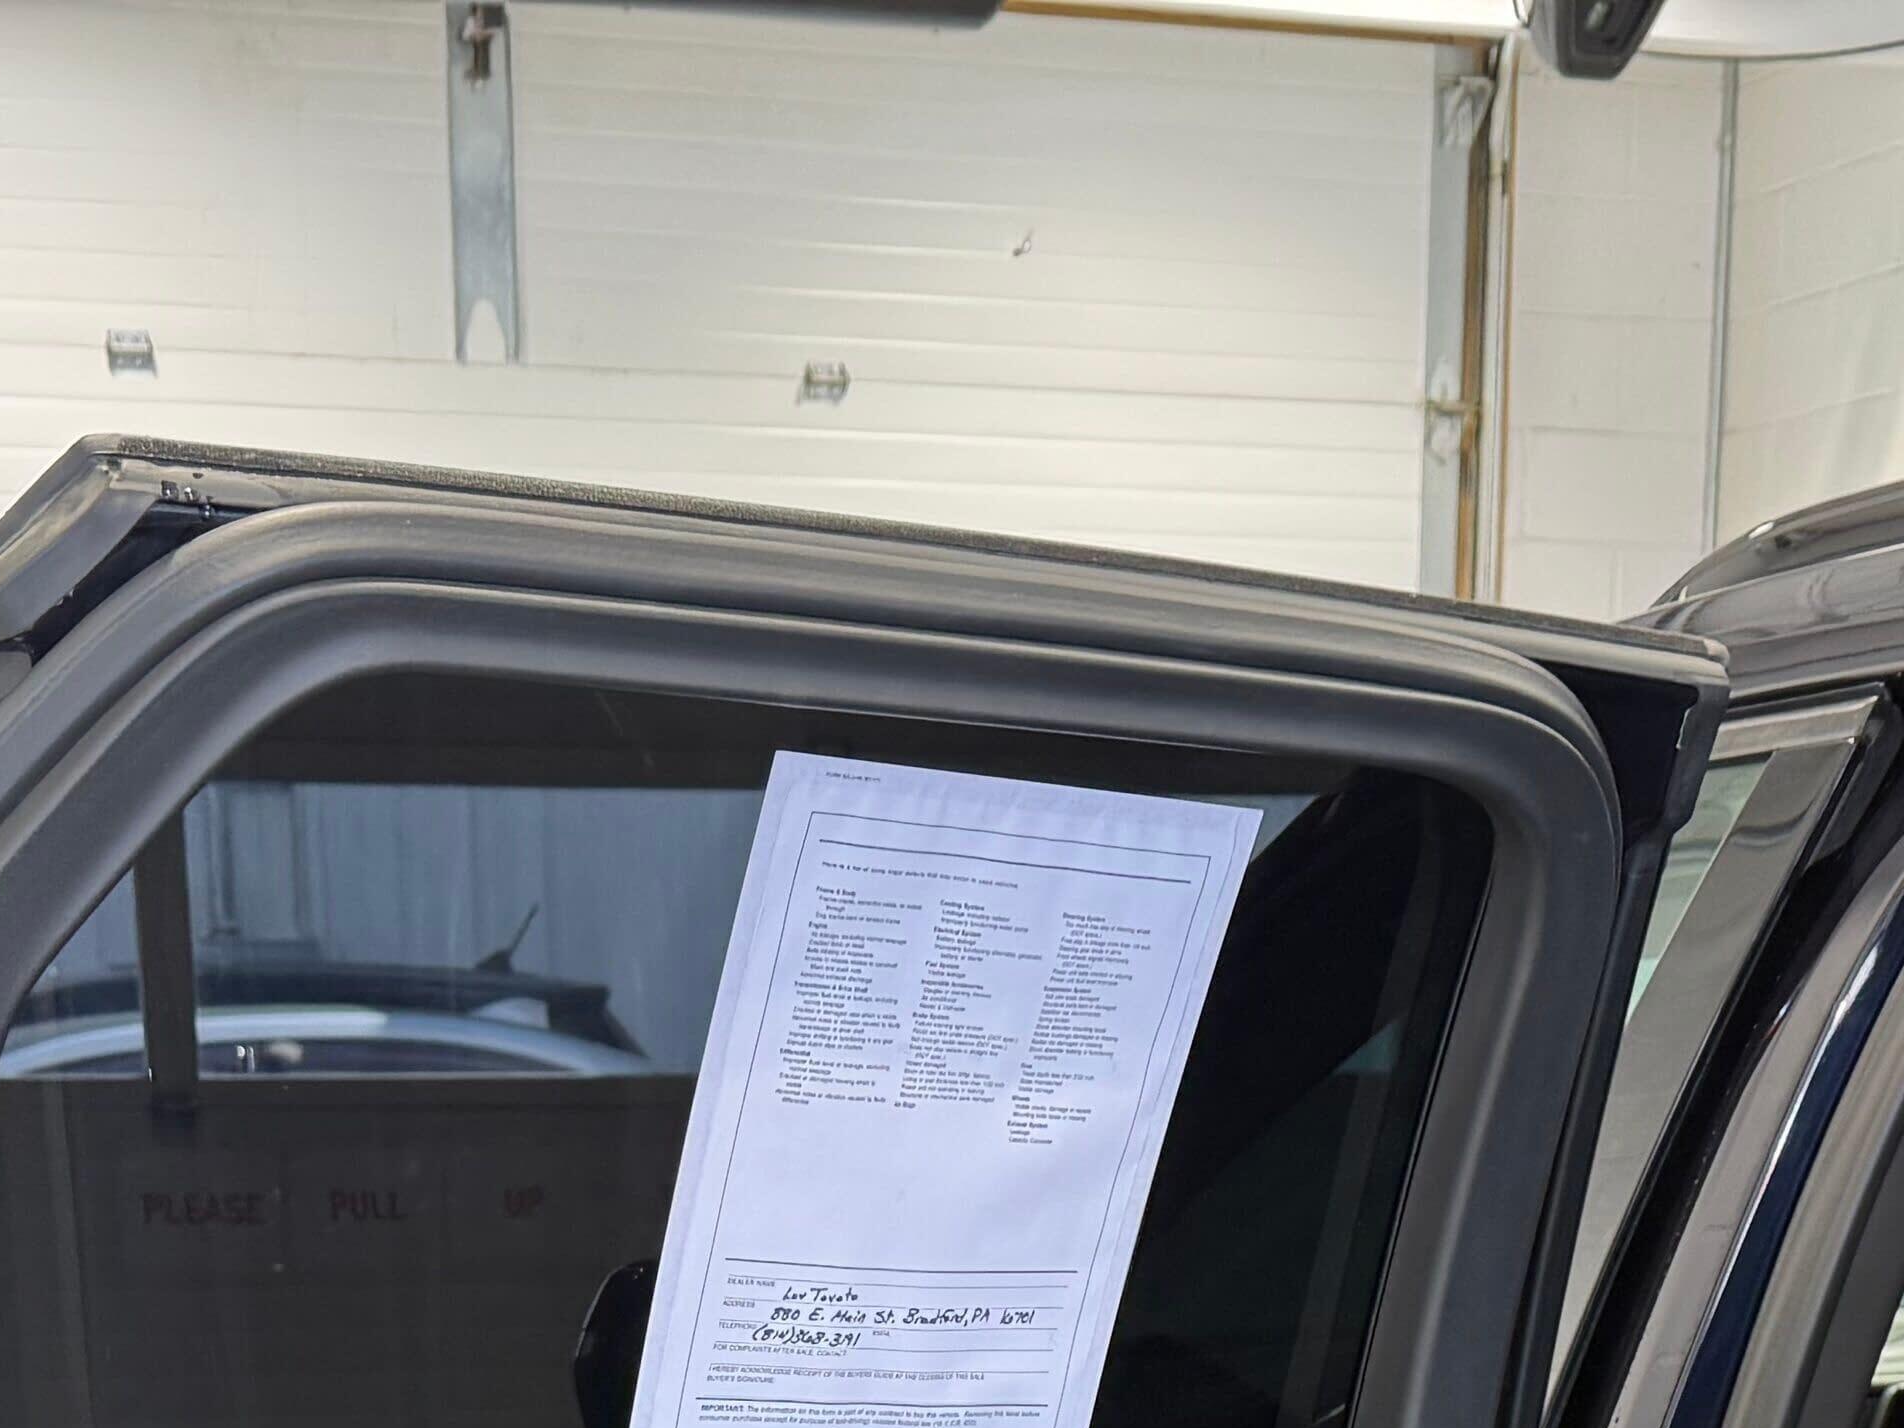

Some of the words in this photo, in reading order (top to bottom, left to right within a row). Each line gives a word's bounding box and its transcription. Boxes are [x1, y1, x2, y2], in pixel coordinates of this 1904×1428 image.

[140, 1191, 267, 1226] PLEASE
[329, 1187, 408, 1222] PULL
[504, 1185, 546, 1219] UP
[770, 1306, 800, 1321] 880
[808, 1307, 824, 1321] E.
[830, 1309, 866, 1323] Main
[874, 1309, 895, 1324] St.
